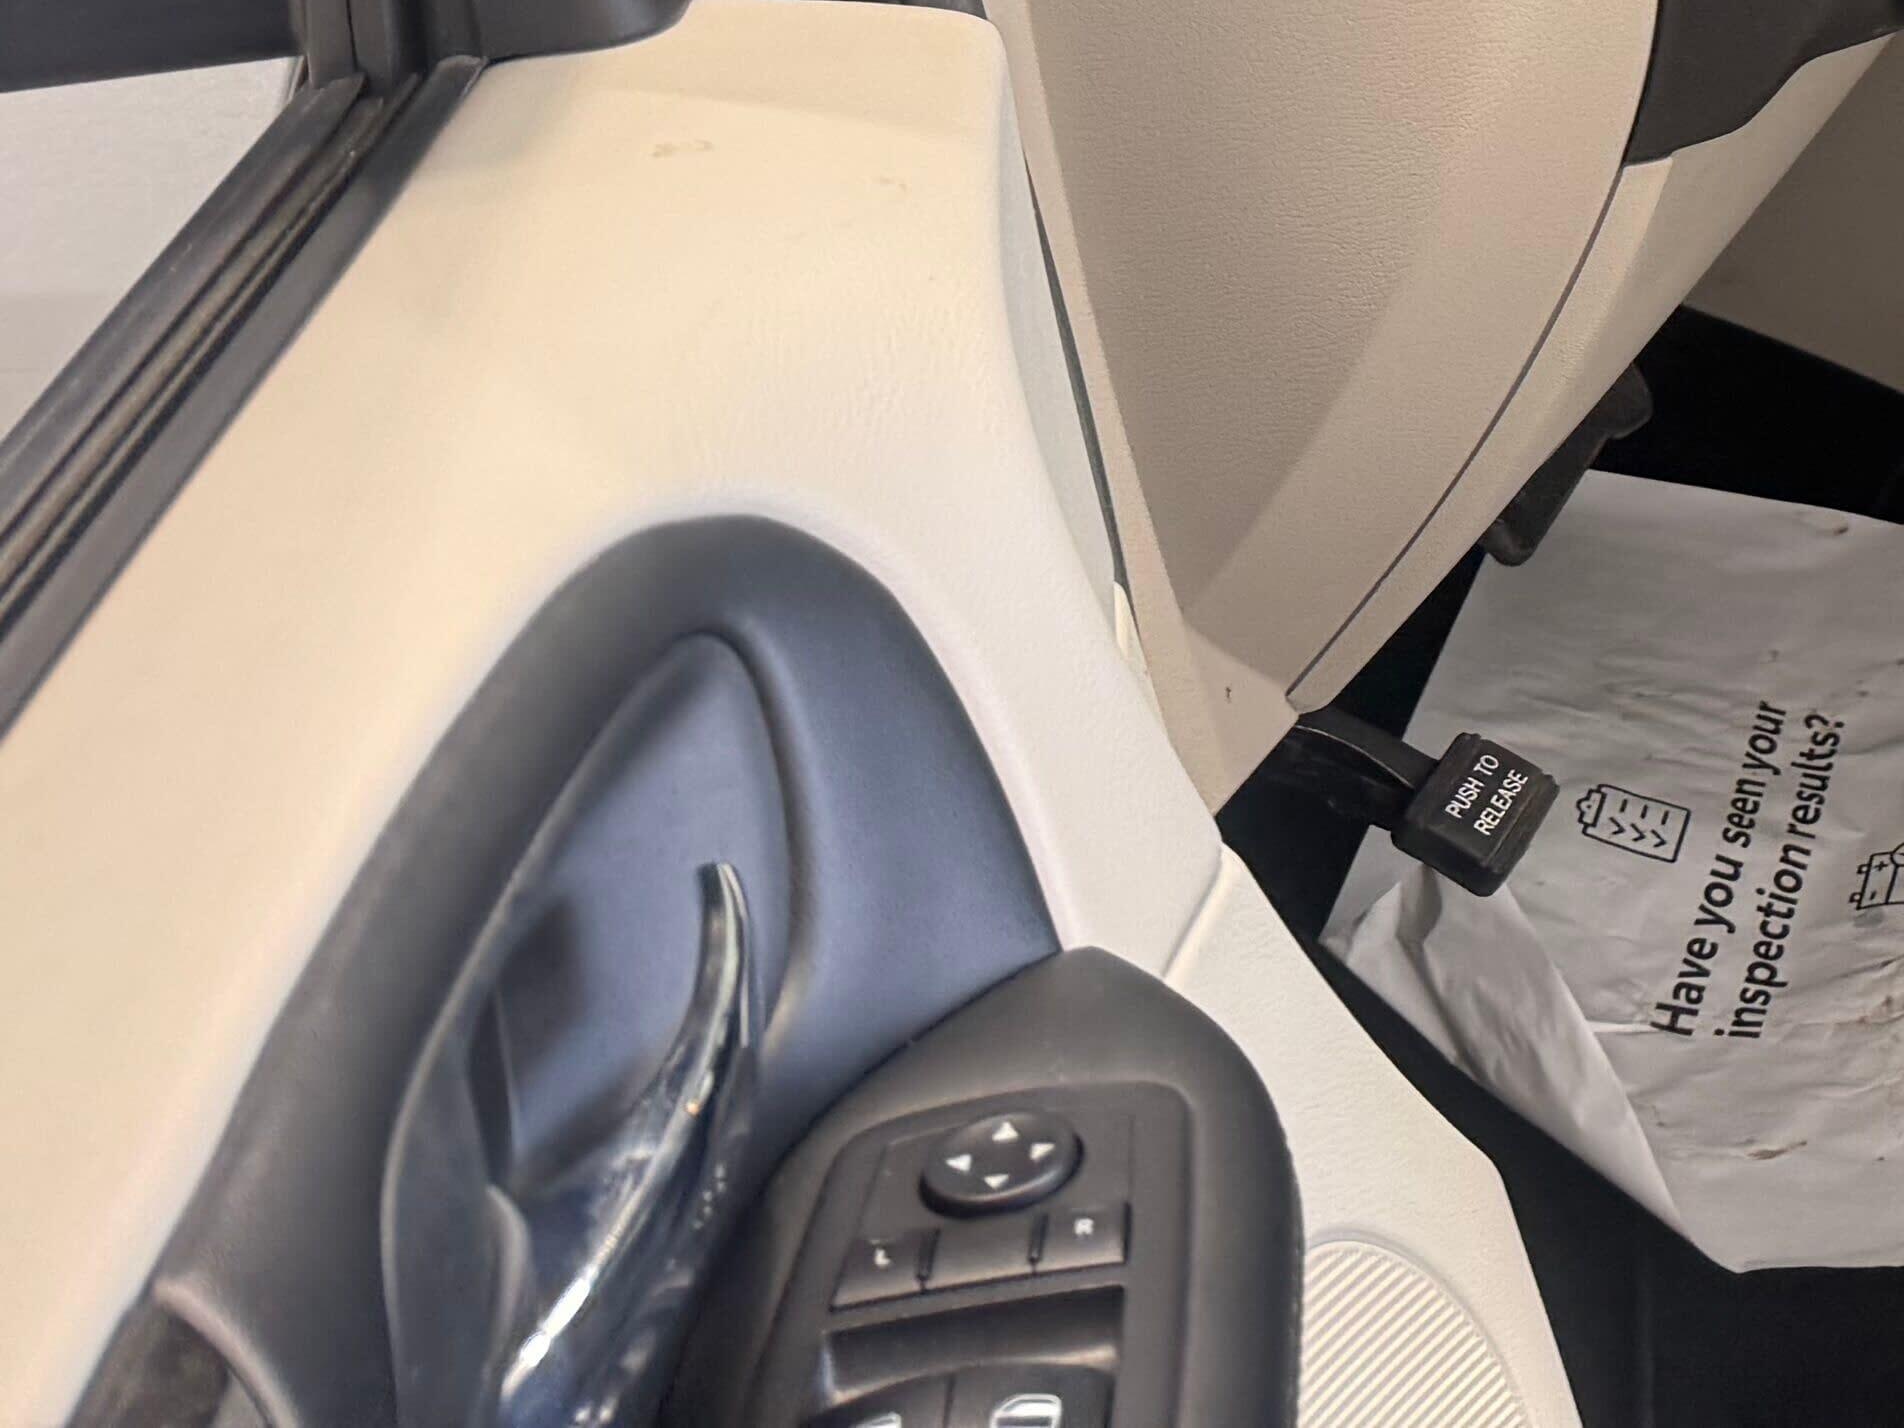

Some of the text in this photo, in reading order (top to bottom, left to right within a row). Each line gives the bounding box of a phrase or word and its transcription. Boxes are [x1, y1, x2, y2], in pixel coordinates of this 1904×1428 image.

[1444, 754, 1499, 819] PUSH TO
[1473, 769, 1529, 836] RELEASE
[1650, 700, 1788, 1037] Have you seen your
[1713, 713, 1845, 1040] inspection results?
